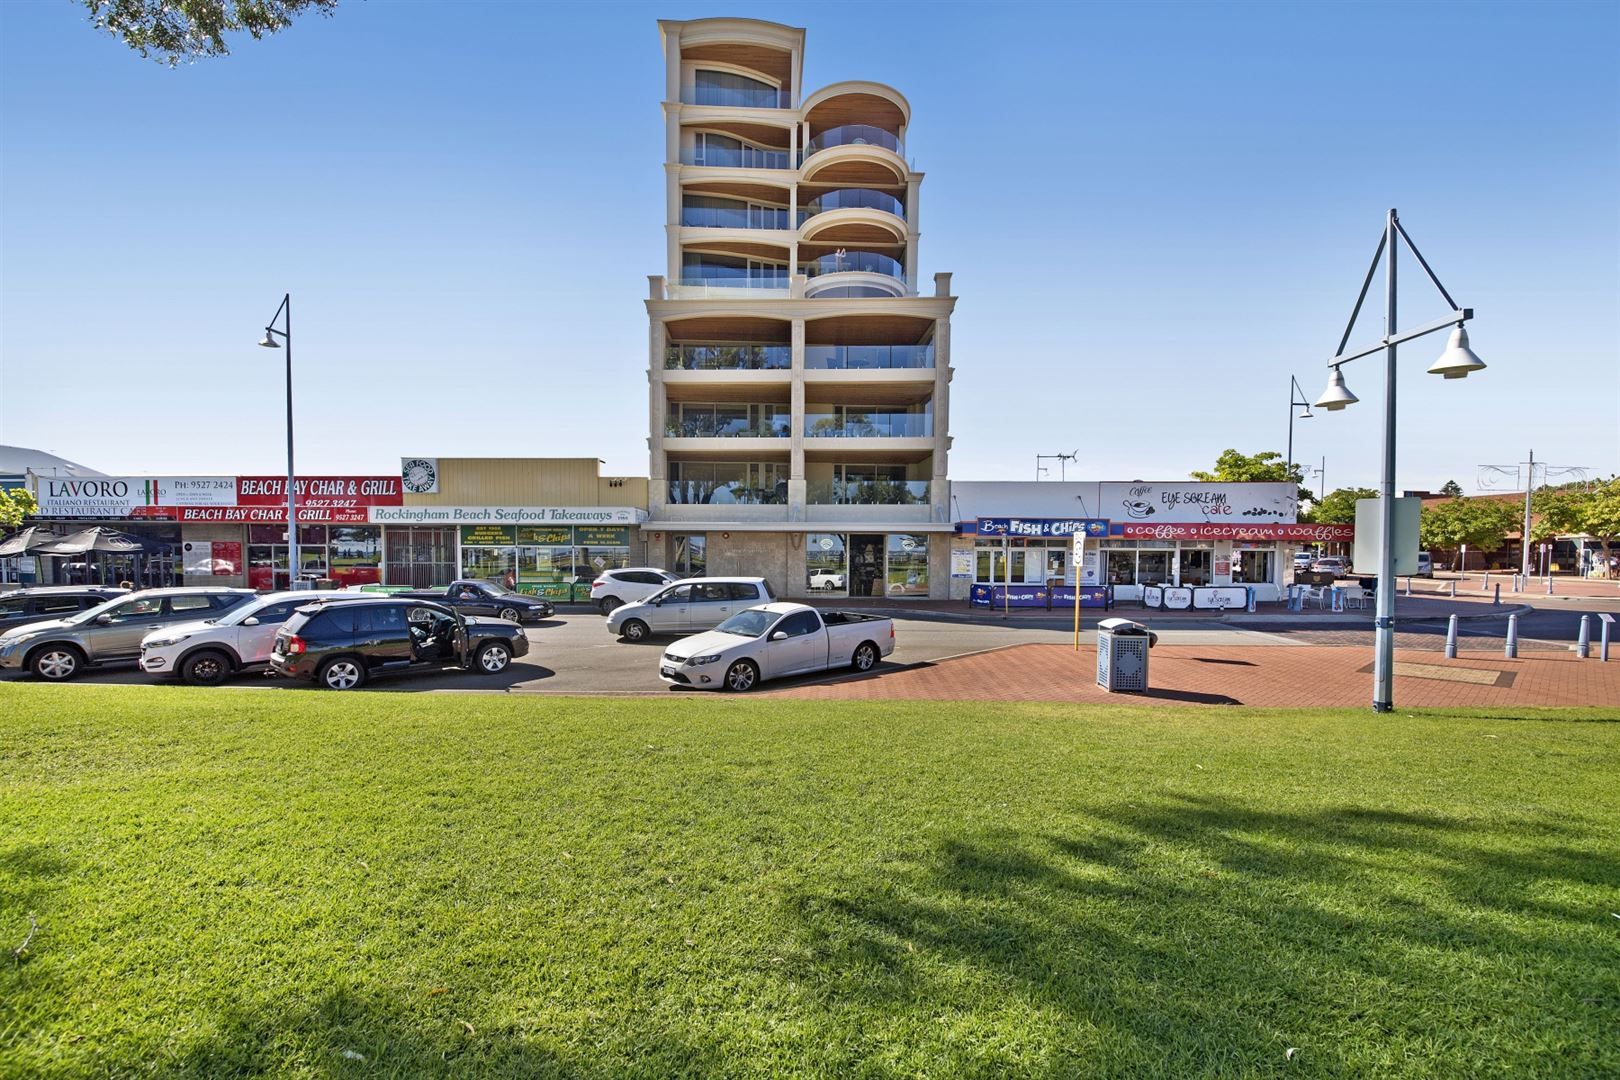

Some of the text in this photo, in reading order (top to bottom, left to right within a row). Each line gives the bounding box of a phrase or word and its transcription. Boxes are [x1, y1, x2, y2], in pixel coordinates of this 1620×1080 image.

[49, 480, 128, 498] LAVORO
[174, 481, 233, 489] PH: 9527 2424
[241, 480, 282, 495] BEACH
[310, 480, 344, 496] CHAR
[347, 480, 357, 496] &
[361, 480, 396, 496] GRILL
[184, 509, 222, 520] BEACH
[225, 509, 248, 520] BAY
[250, 509, 283, 520] CHAR
[298, 509, 332, 520] GRILL
[375, 508, 612, 522] Rockingham Beach Seafood Takeaways
[980, 520, 1008, 532] Beach
[1010, 520, 1041, 535] FISH
[1043, 523, 1049, 533] &
[1135, 525, 1354, 540] coffee icecream waffles
